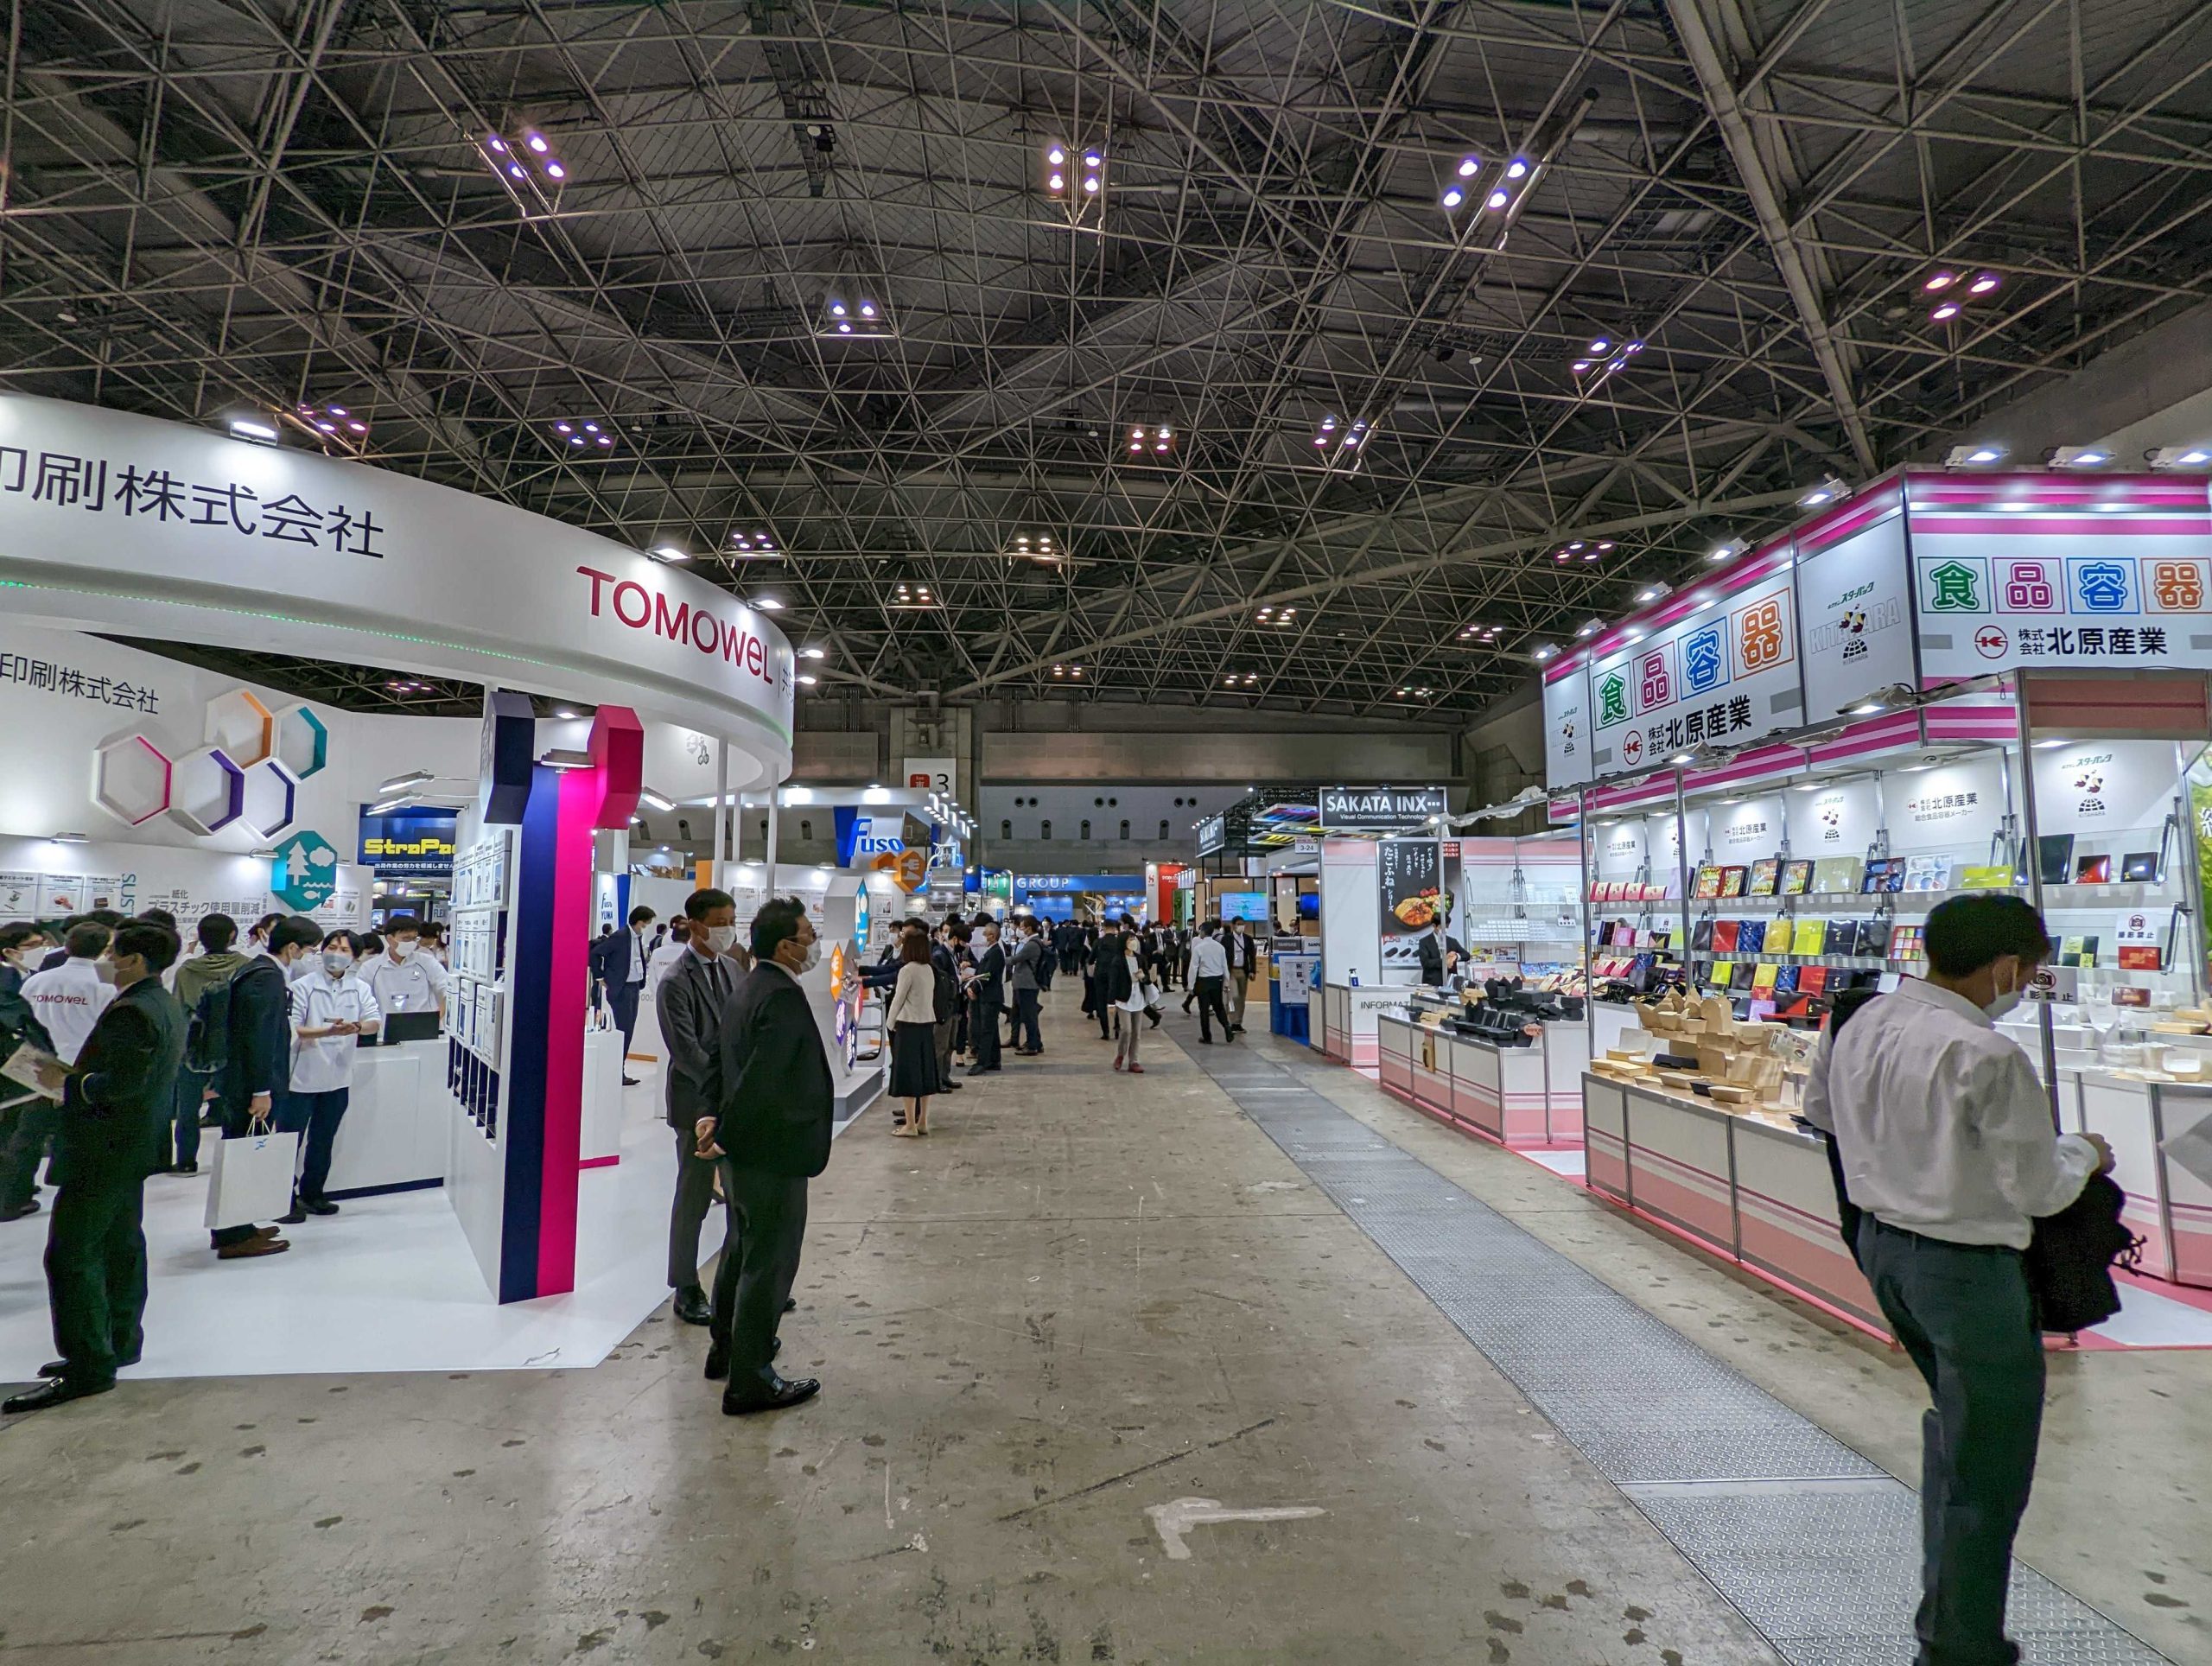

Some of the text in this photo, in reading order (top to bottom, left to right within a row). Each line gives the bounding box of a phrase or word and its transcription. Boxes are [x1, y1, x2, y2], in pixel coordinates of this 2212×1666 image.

[1929, 560, 2204, 611] 食品容器
[2047, 626, 2168, 656] 北原産業
[1599, 599, 1784, 725] 食品容器
[0, 652, 159, 715] 印刷株式会社
[1665, 695, 1752, 750] 北原産業
[936, 773, 949, 793] 3
[1326, 796, 1427, 812] SAKATA INX
[1932, 792, 1978, 810] 北原産業
[1016, 877, 1069, 889] GROUP
